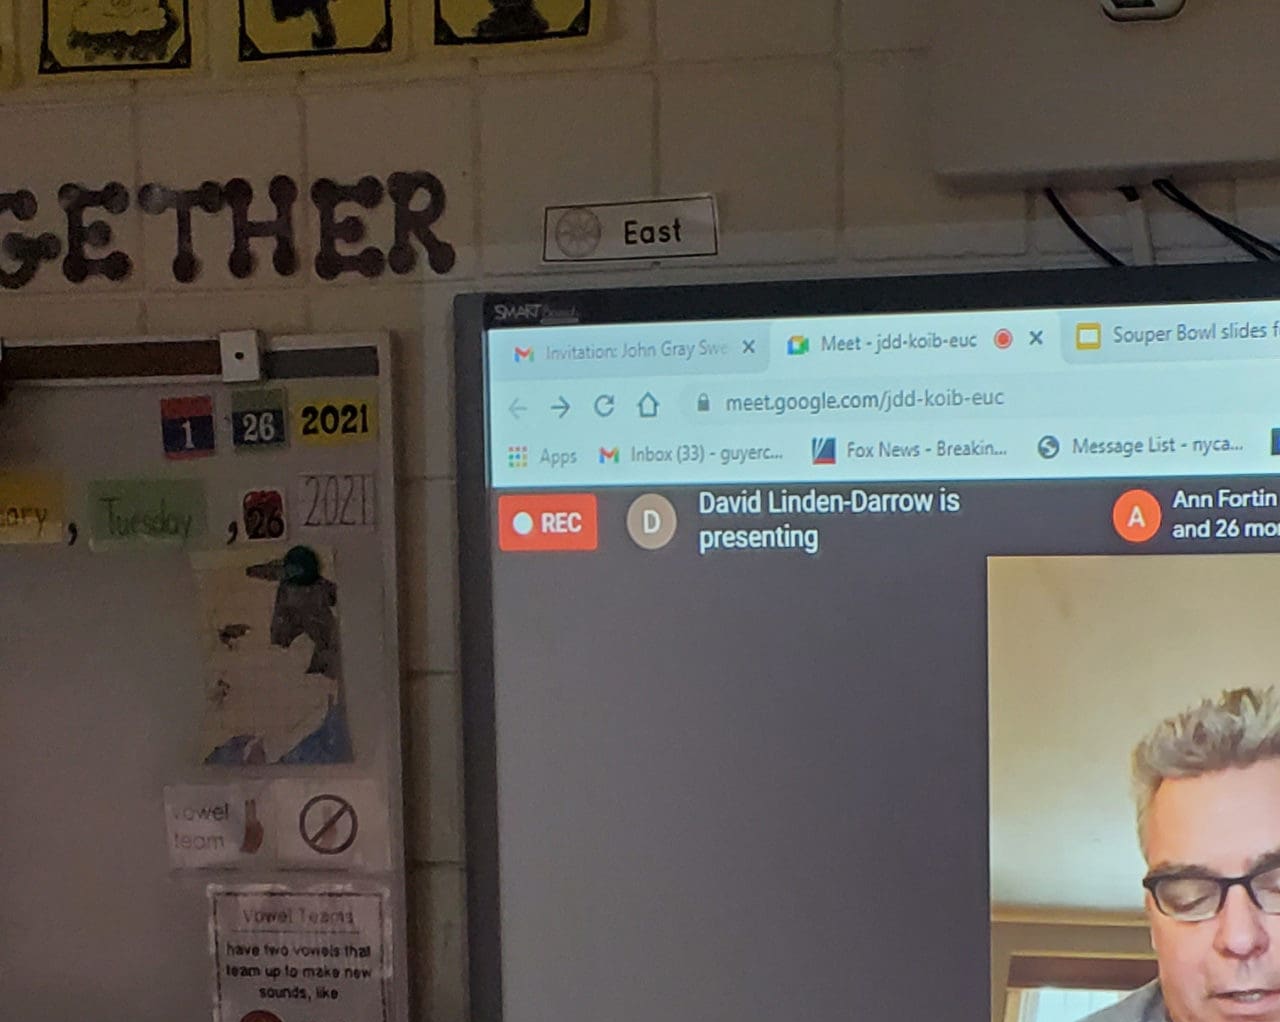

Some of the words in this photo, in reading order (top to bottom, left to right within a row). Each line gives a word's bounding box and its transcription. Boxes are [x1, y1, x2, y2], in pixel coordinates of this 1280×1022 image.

[622, 218, 683, 246] East
[494, 303, 542, 320] SMART
[821, 335, 861, 351] Meet
[874, 332, 978, 354] jdd-koib-euc
[1113, 325, 1171, 346] Souper
[1176, 323, 1216, 341] Bowl
[1221, 321, 1268, 339] slides
[546, 343, 618, 360] Invitation:
[621, 341, 656, 359] John
[660, 339, 696, 361] Gray
[726, 388, 1005, 415] meet.google.com/jdd-koib-euc
[243, 412, 275, 442] 26
[302, 403, 369, 436] 2021
[181, 419, 196, 450] 1
[540, 447, 577, 468] Apps
[631, 445, 673, 463] Inbox
[676, 443, 705, 465] (33)
[720, 446, 784, 466] guyerc...
[847, 441, 875, 459] Fox
[878, 441, 920, 458] News
[936, 439, 1007, 457] Breakin...
[1072, 437, 1143, 458] Message
[1149, 436, 1176, 453] List
[1192, 437, 1244, 457] nyca...
[305, 476, 367, 526] 2021
[699, 490, 762, 515] David
[767, 488, 933, 515] Linden-Darrow
[940, 486, 960, 512] is
[1172, 490, 1213, 509] Ann
[1218, 488, 1278, 508] Fortin
[0, 508, 47, 538] ary
[247, 508, 287, 540] 26
[541, 512, 583, 534] REC
[643, 510, 659, 534] D
[1127, 506, 1146, 528] A
[699, 525, 819, 554] presenting
[1172, 518, 1210, 539] and
[1214, 518, 1241, 538] 26
[243, 909, 293, 924] Vowel
[226, 942, 260, 957] have
[264, 943, 289, 957] two
[295, 943, 340, 957] vowels
[344, 943, 371, 958] that
[226, 964, 261, 978] team
[265, 967, 281, 981] up
[285, 964, 298, 978] to
[303, 964, 340, 978] make
[344, 967, 372, 979] new
[259, 986, 312, 1001] sounds,
[315, 986, 339, 1000] like
